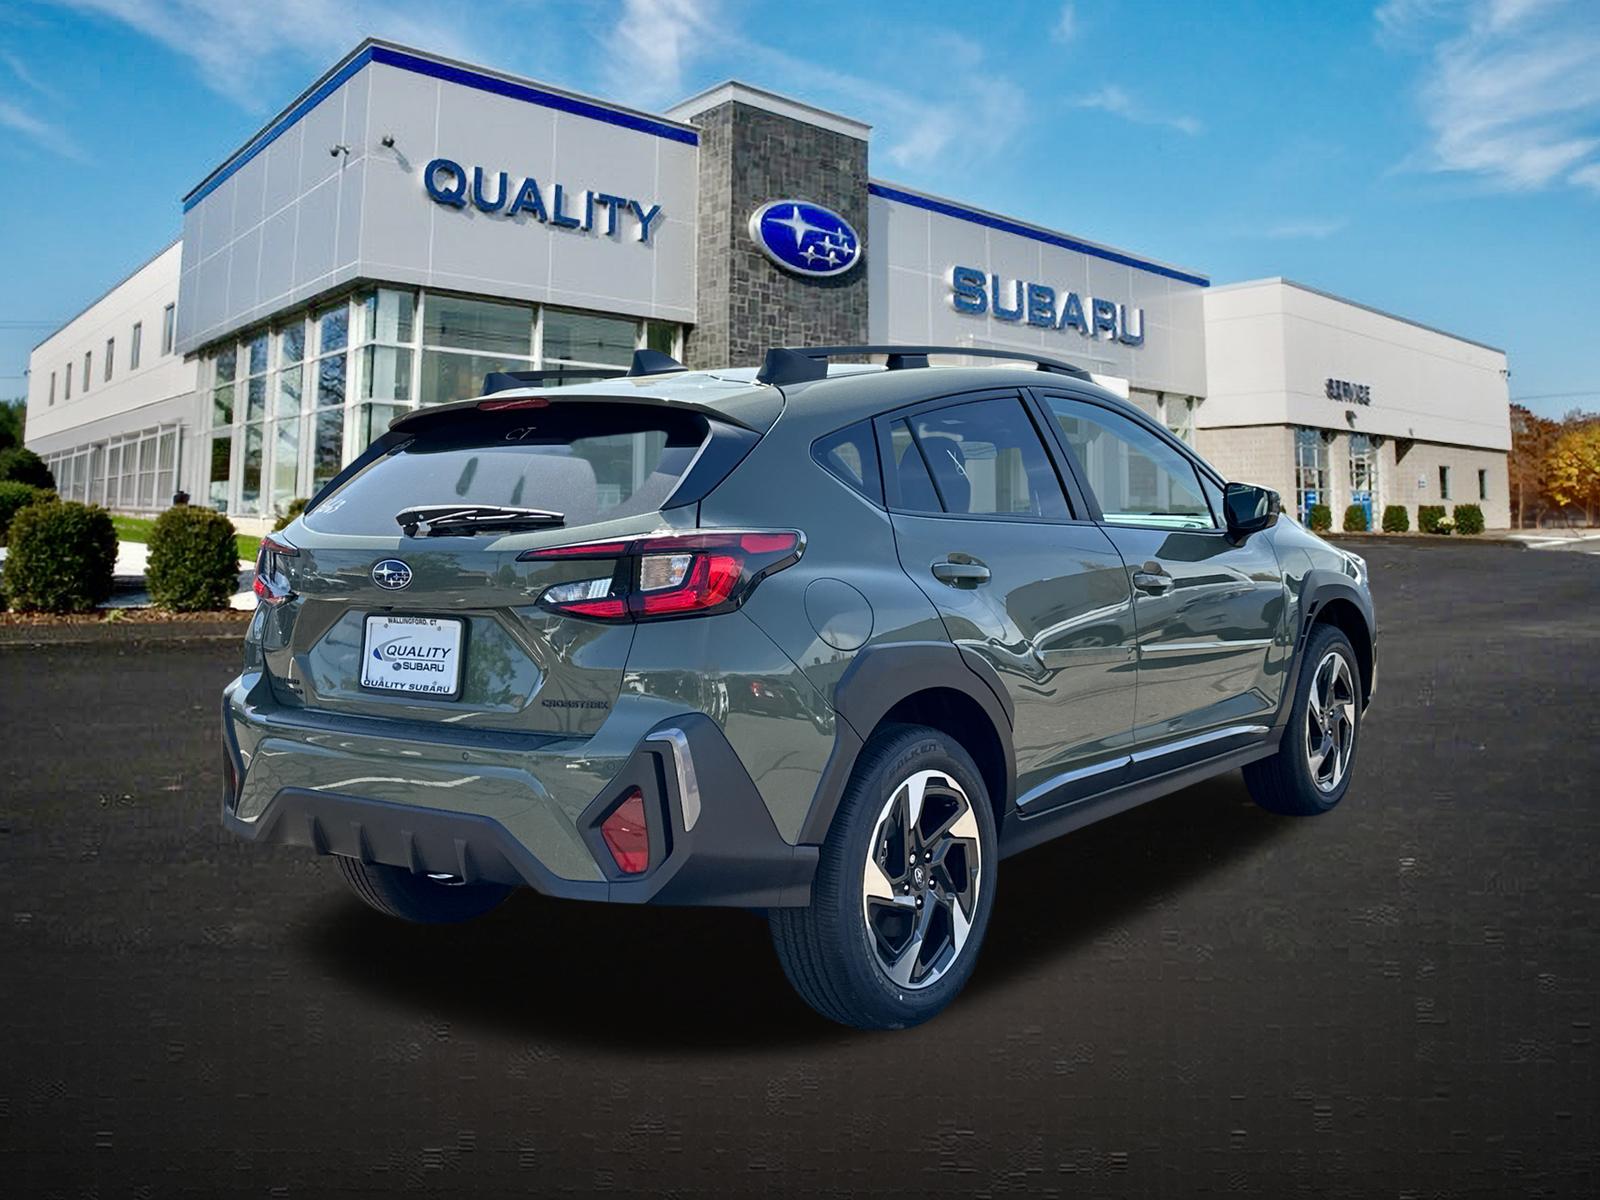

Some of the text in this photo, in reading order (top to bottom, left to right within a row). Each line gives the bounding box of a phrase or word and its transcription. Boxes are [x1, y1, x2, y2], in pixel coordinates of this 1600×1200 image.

[424, 158, 661, 242] QUALITY
[952, 265, 1145, 346] SUBARU
[1326, 378, 1371, 406] SERVICE
[386, 645, 451, 658] QUALITY
[402, 662, 445, 672] SUBARU
[363, 679, 450, 693] QUALITY SUBARU
[541, 699, 609, 709] CROSSTREK
